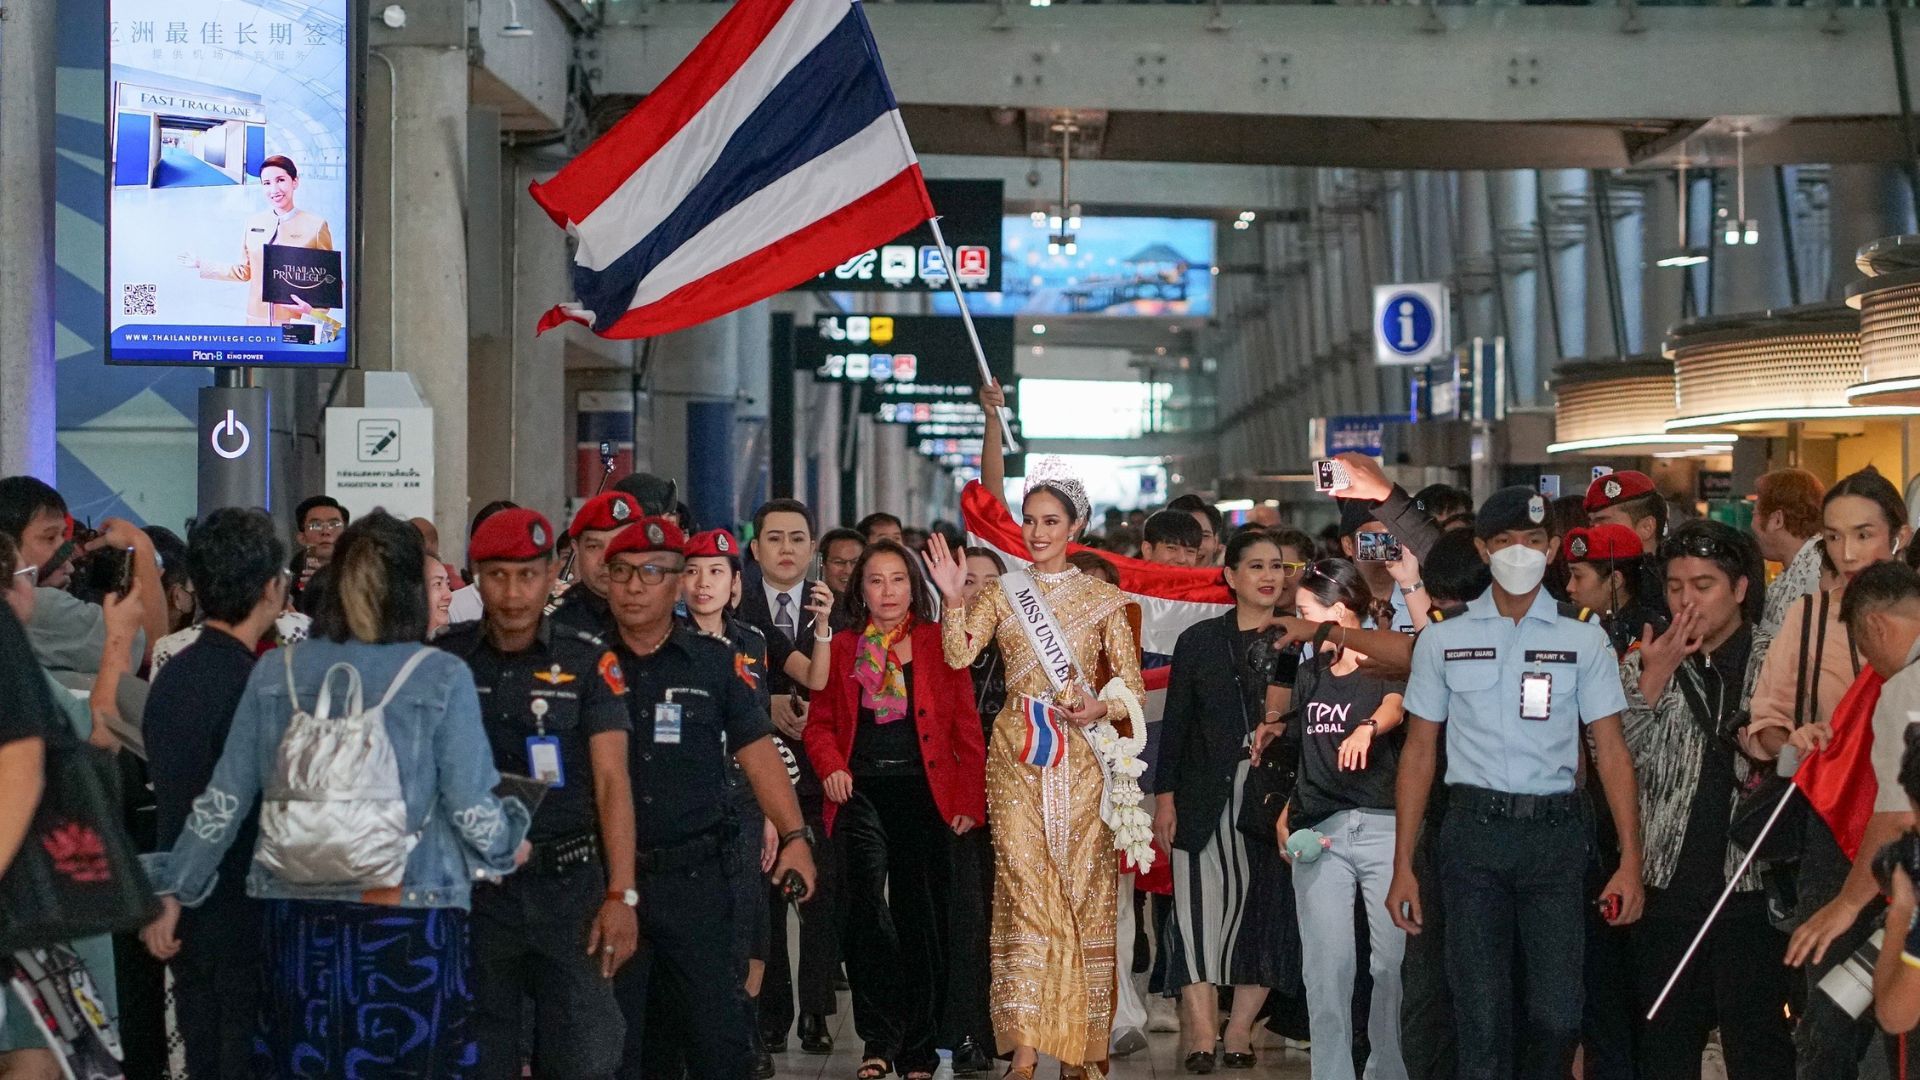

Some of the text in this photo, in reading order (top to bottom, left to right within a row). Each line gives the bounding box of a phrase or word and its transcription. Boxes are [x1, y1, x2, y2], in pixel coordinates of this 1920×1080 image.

[141, 92, 251, 117] FAST TRACK LANE
[283, 264, 327, 277] THAILAND
[1015, 588, 1043, 625] MISS
[1446, 651, 1473, 659] SECURITY
[1306, 702, 1351, 723] TPN
